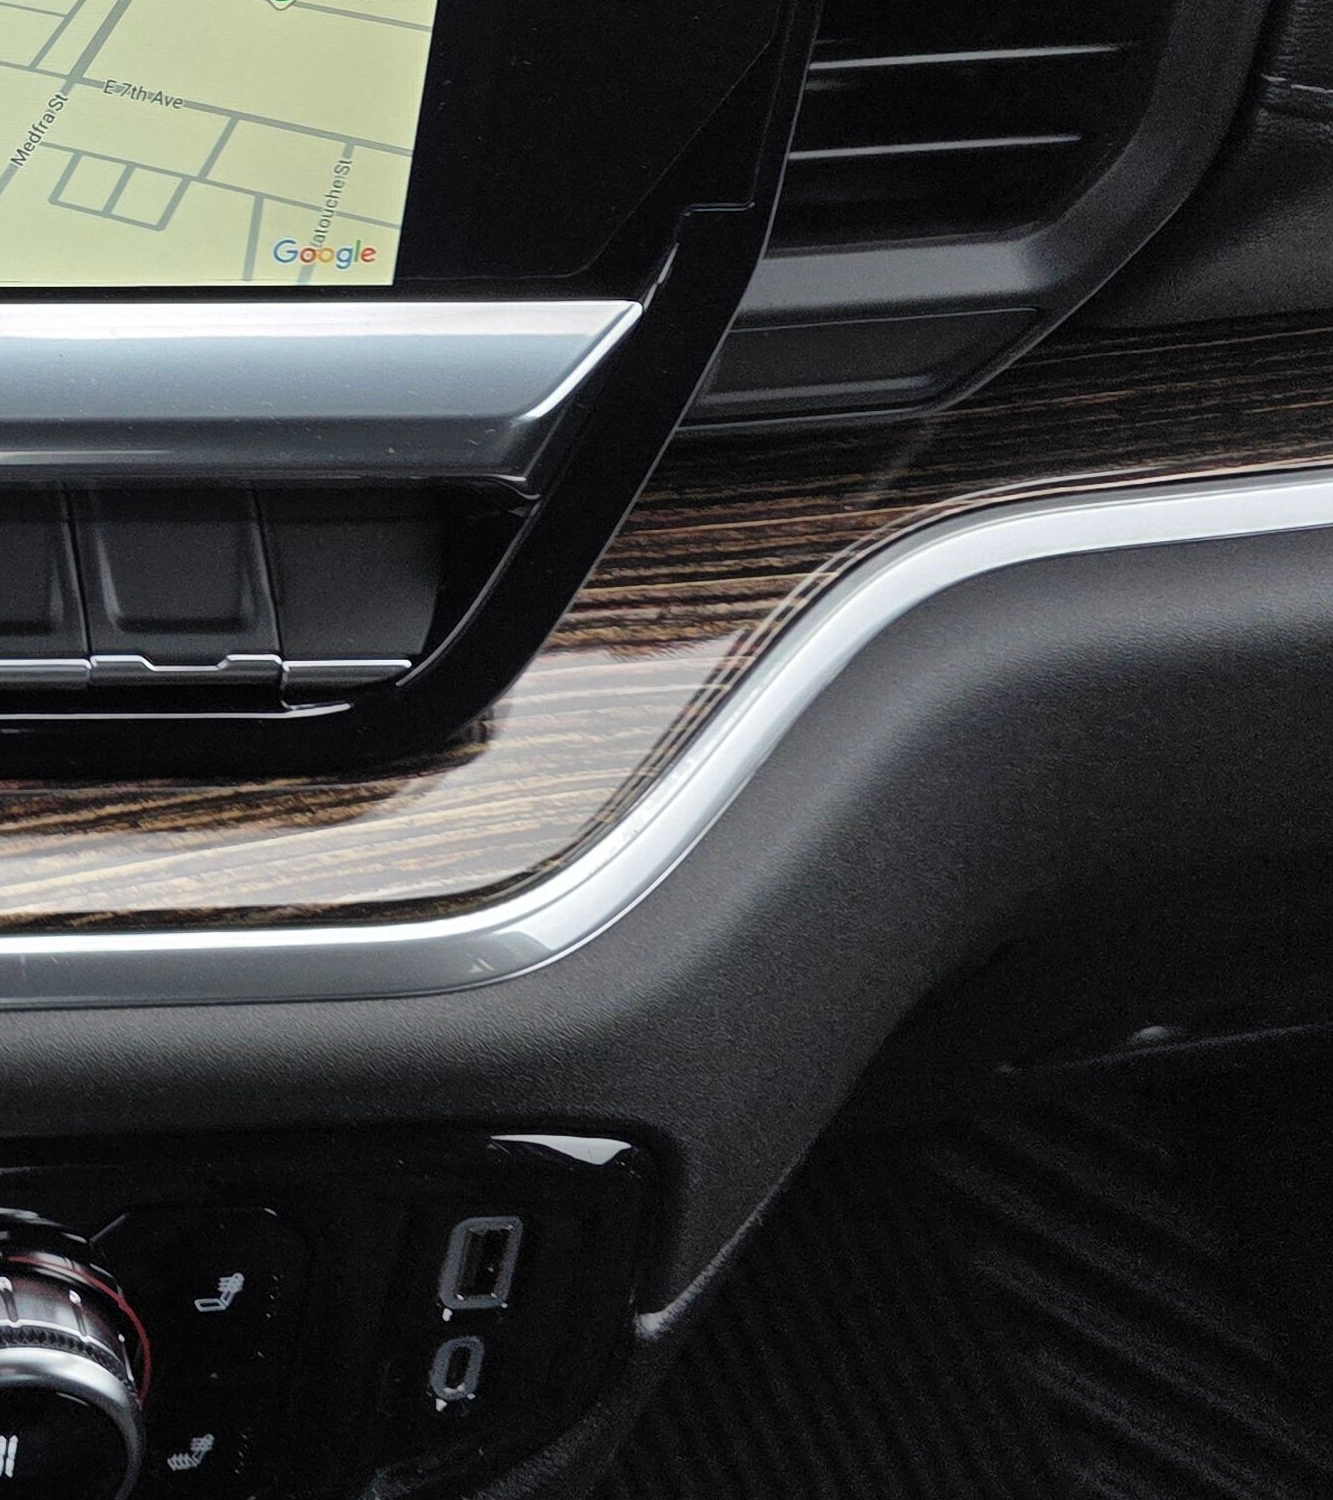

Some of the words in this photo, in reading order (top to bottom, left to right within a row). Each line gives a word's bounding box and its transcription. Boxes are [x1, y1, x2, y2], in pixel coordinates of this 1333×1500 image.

[103, 80, 116, 94] E
[119, 82, 148, 102] 7th
[151, 91, 184, 110] Ave
[11, 110, 55, 167] Medfra
[48, 94, 69, 113] St
[335, 158, 353, 178] St
[273, 238, 377, 269] Google
